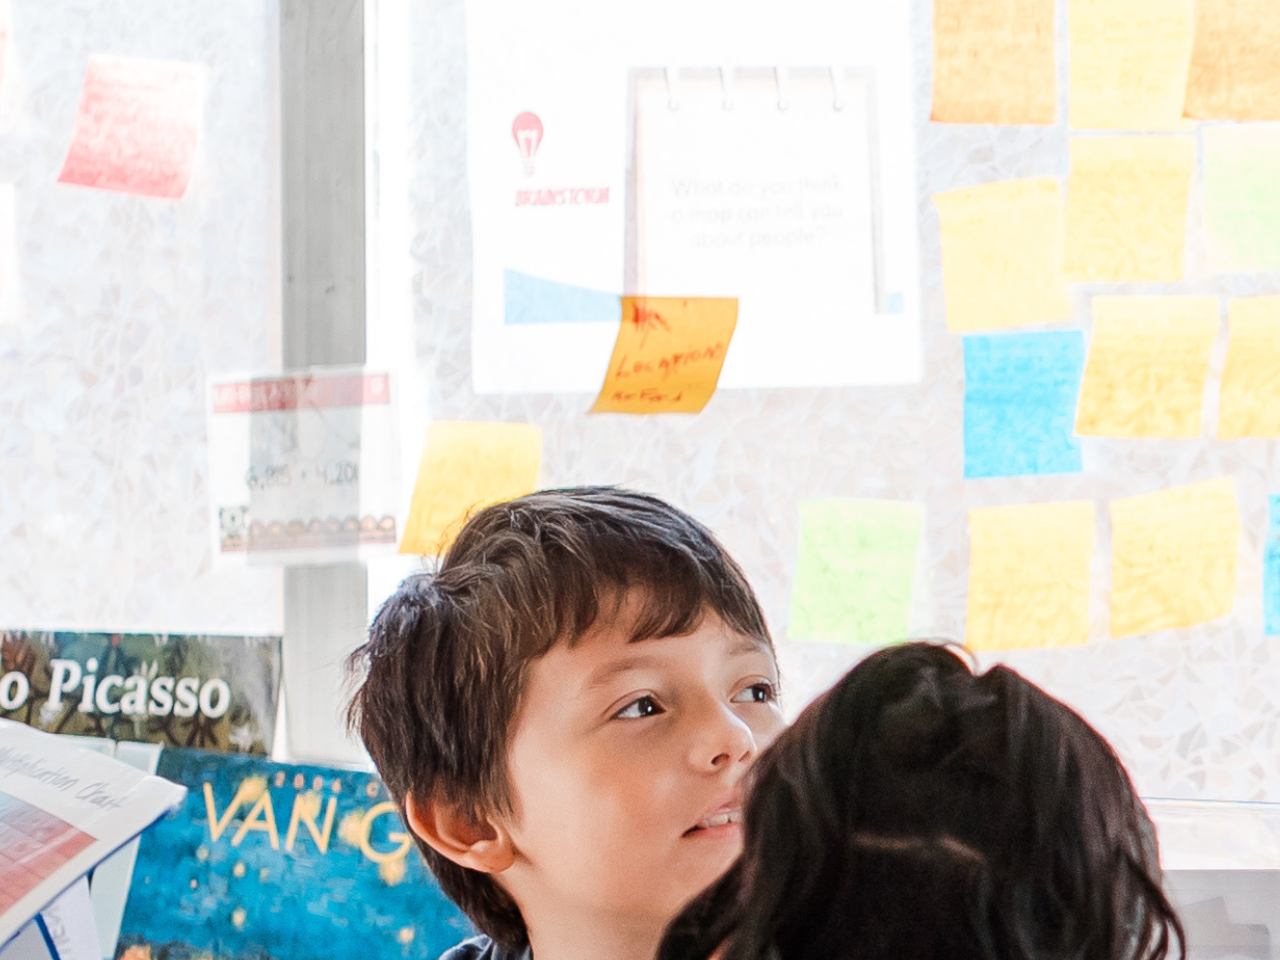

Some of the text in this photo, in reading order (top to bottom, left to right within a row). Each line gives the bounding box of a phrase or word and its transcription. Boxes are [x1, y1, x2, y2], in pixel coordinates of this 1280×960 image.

[515, 187, 611, 206] BRAINSTORM
[671, 174, 840, 199] What do you think
[689, 207, 733, 225] map
[737, 206, 771, 221] can
[776, 202, 804, 219] tell
[811, 203, 844, 221] you
[691, 227, 826, 250] about people?
[46, 656, 231, 719] Picasso
[75, 781, 128, 811] Chart
[202, 781, 412, 864] VAN G
